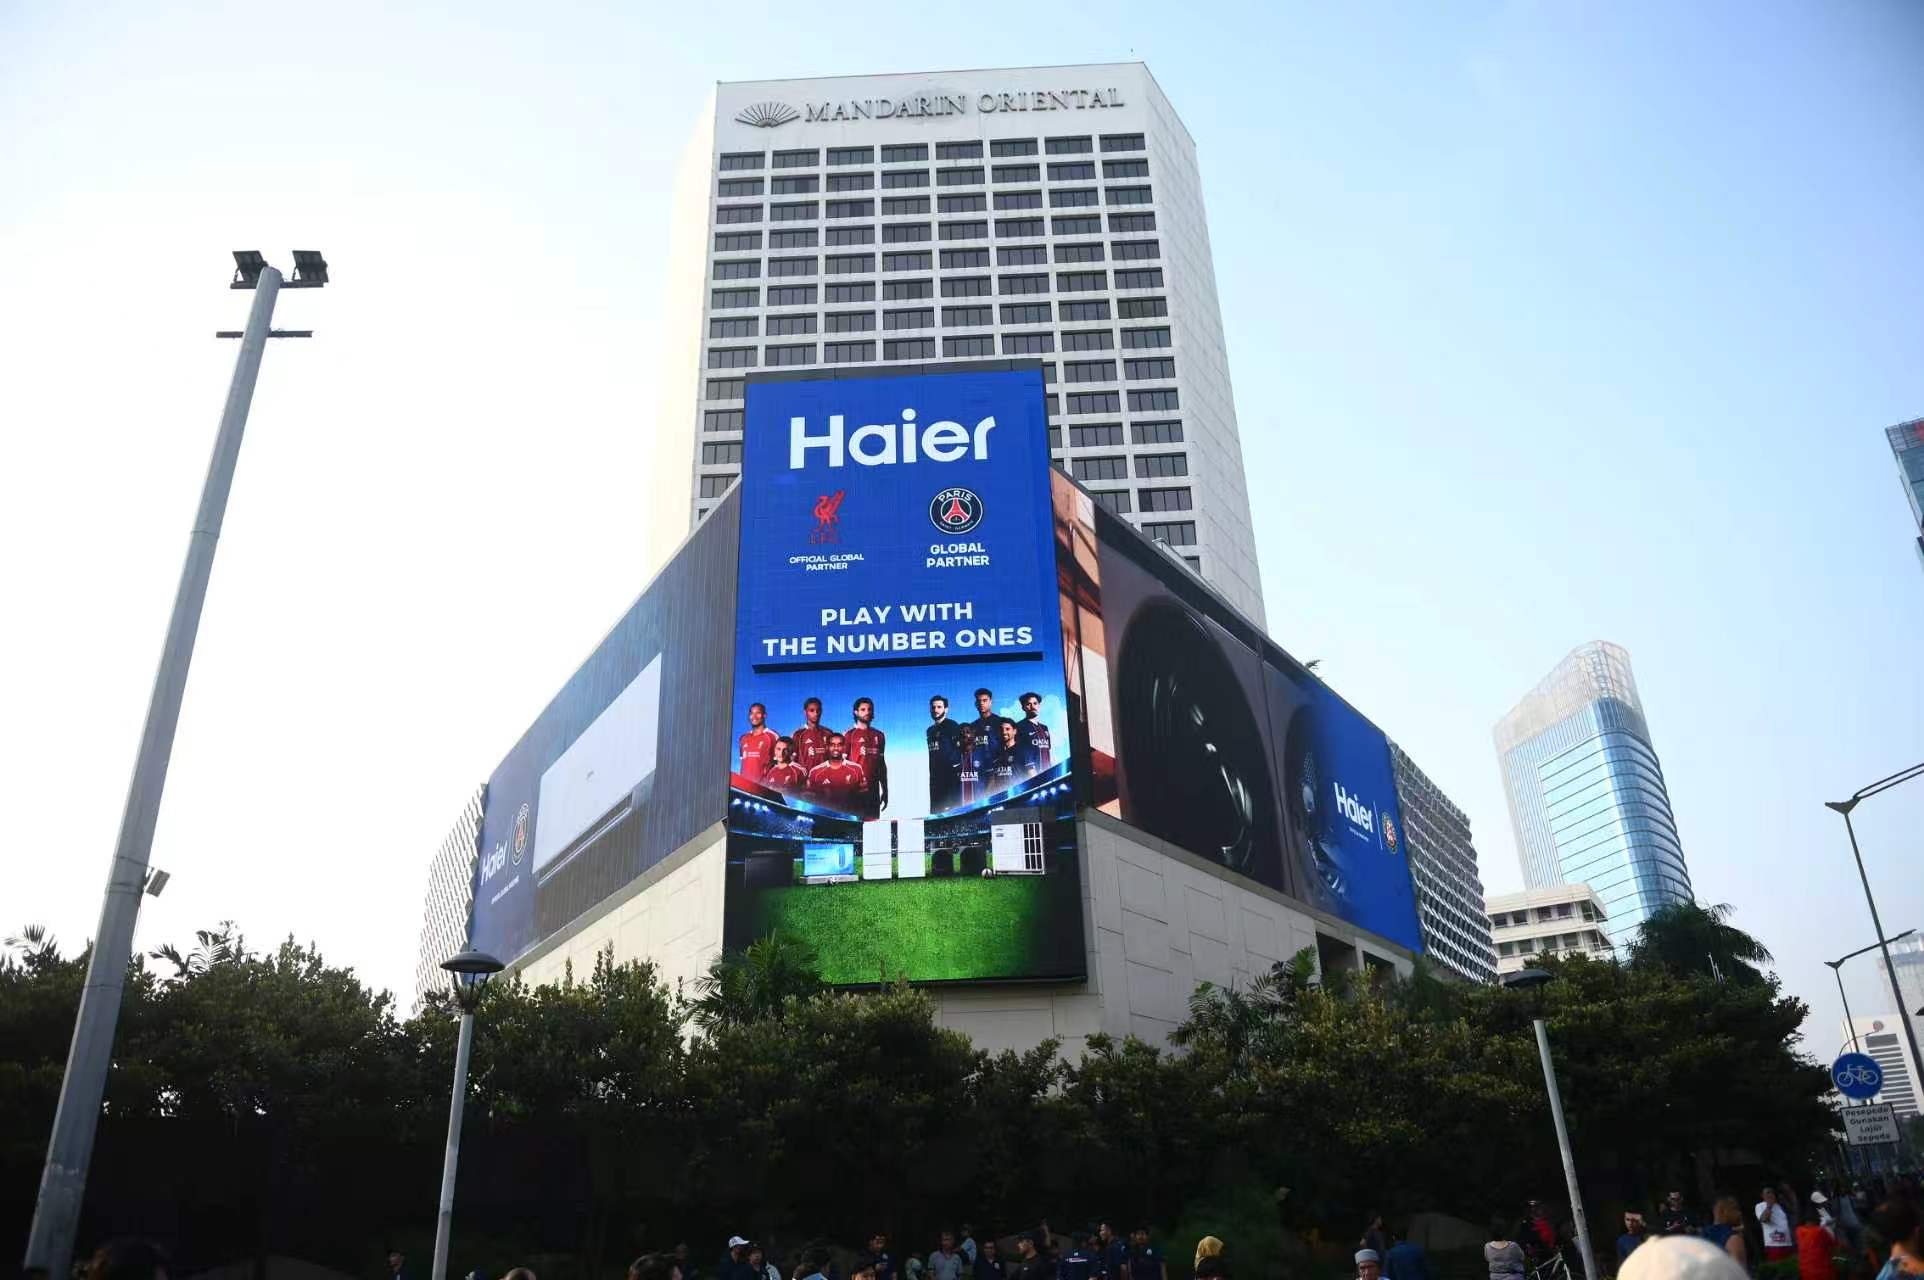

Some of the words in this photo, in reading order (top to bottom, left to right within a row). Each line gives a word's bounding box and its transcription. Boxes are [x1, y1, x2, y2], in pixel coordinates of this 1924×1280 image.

[805, 95, 966, 122] MANDARIN
[977, 88, 1125, 113] ORIENTAL
[789, 408, 996, 470] Haier
[938, 490, 973, 502] PARIS
[789, 555, 828, 564] OFFICIAL
[829, 553, 865, 562] GLOBAL
[930, 542, 986, 555] GLOBAL
[805, 562, 848, 571] PARTNER
[926, 555, 990, 568] PARTNER
[820, 606, 892, 627] PLAY
[899, 602, 973, 623] WITH
[762, 636, 817, 657] THE
[827, 630, 946, 654] NUMBER
[955, 626, 1033, 647] ONES
[1333, 781, 1374, 833] Haier
[480, 840, 508, 886] Haier
